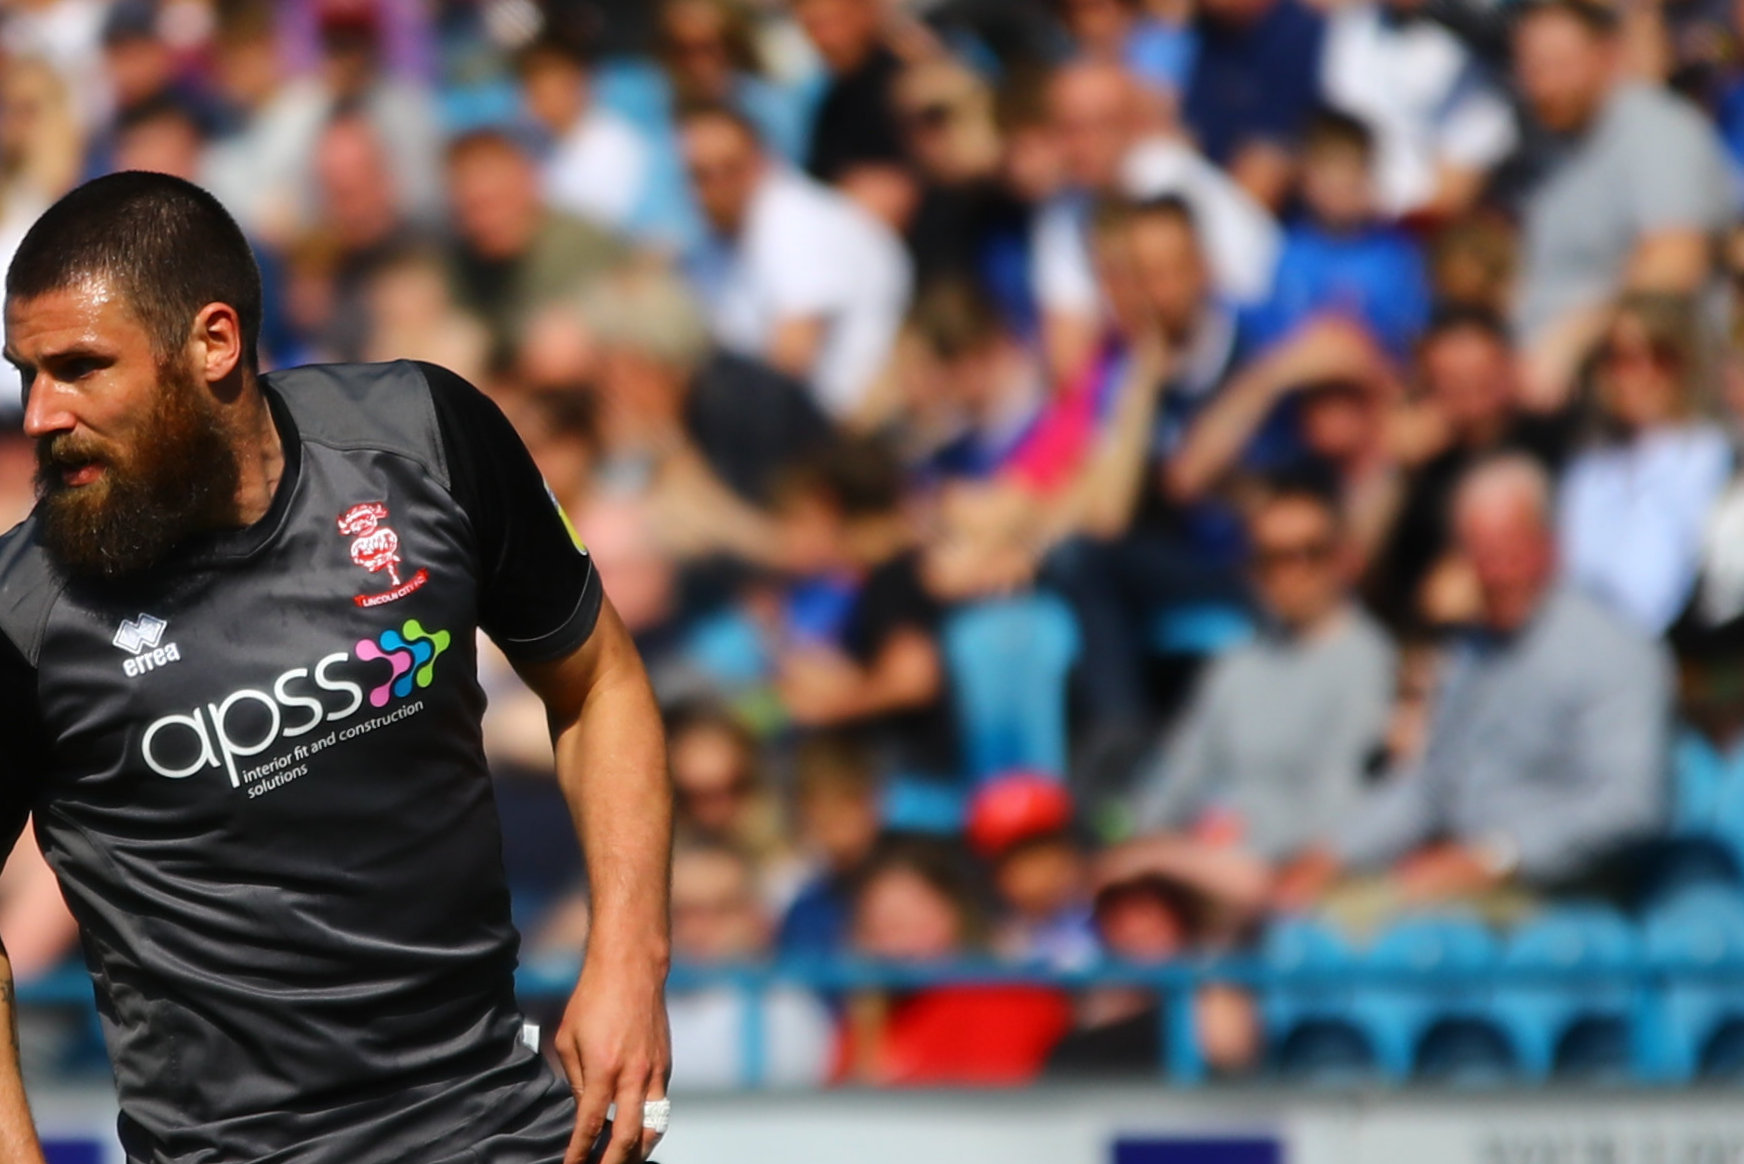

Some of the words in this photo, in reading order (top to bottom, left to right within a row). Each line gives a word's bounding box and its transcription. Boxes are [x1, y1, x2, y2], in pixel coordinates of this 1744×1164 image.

[122, 642, 181, 677] errea
[142, 652, 363, 789] apss
[242, 753, 292, 783] interior
[294, 745, 309, 761] fit
[311, 731, 336, 754] and
[338, 700, 424, 741] construction
[247, 763, 308, 799] solutions
